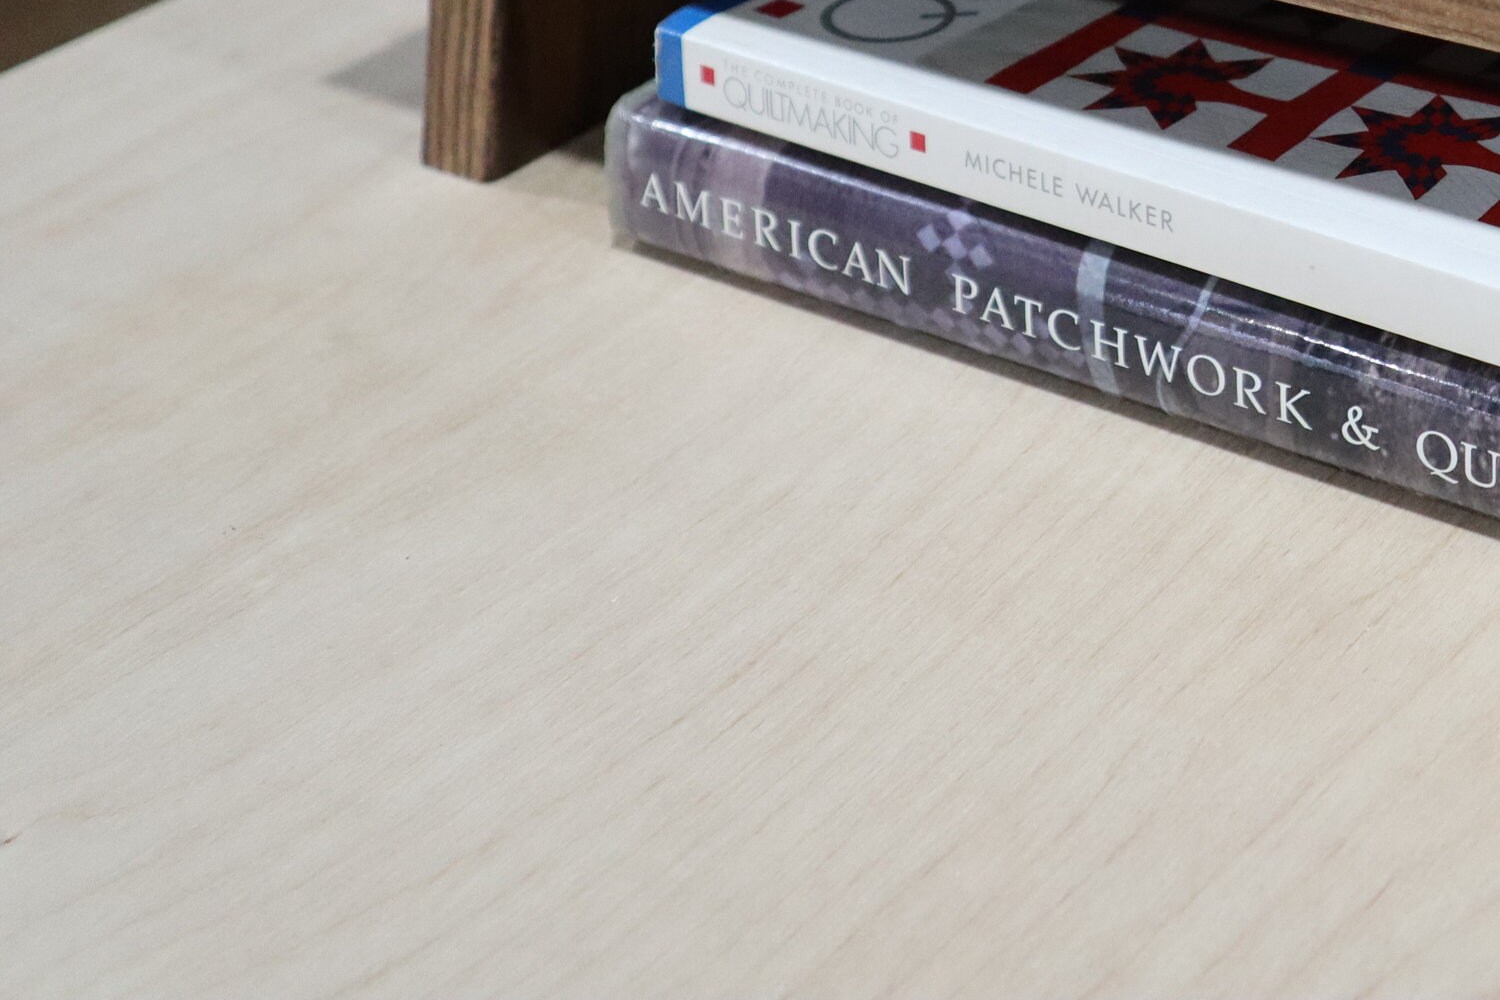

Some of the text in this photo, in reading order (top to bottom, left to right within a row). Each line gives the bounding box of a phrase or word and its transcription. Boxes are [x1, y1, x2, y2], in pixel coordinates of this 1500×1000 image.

[722, 59, 899, 124] THE COMPLETE BOOK OF
[723, 76, 899, 159] QUILTMAKING
[964, 150, 1174, 234] MICHELE WALKER
[640, 173, 912, 296] AMERICAN
[951, 273, 1312, 432] PATCHWORK
[1341, 405, 1381, 452] &
